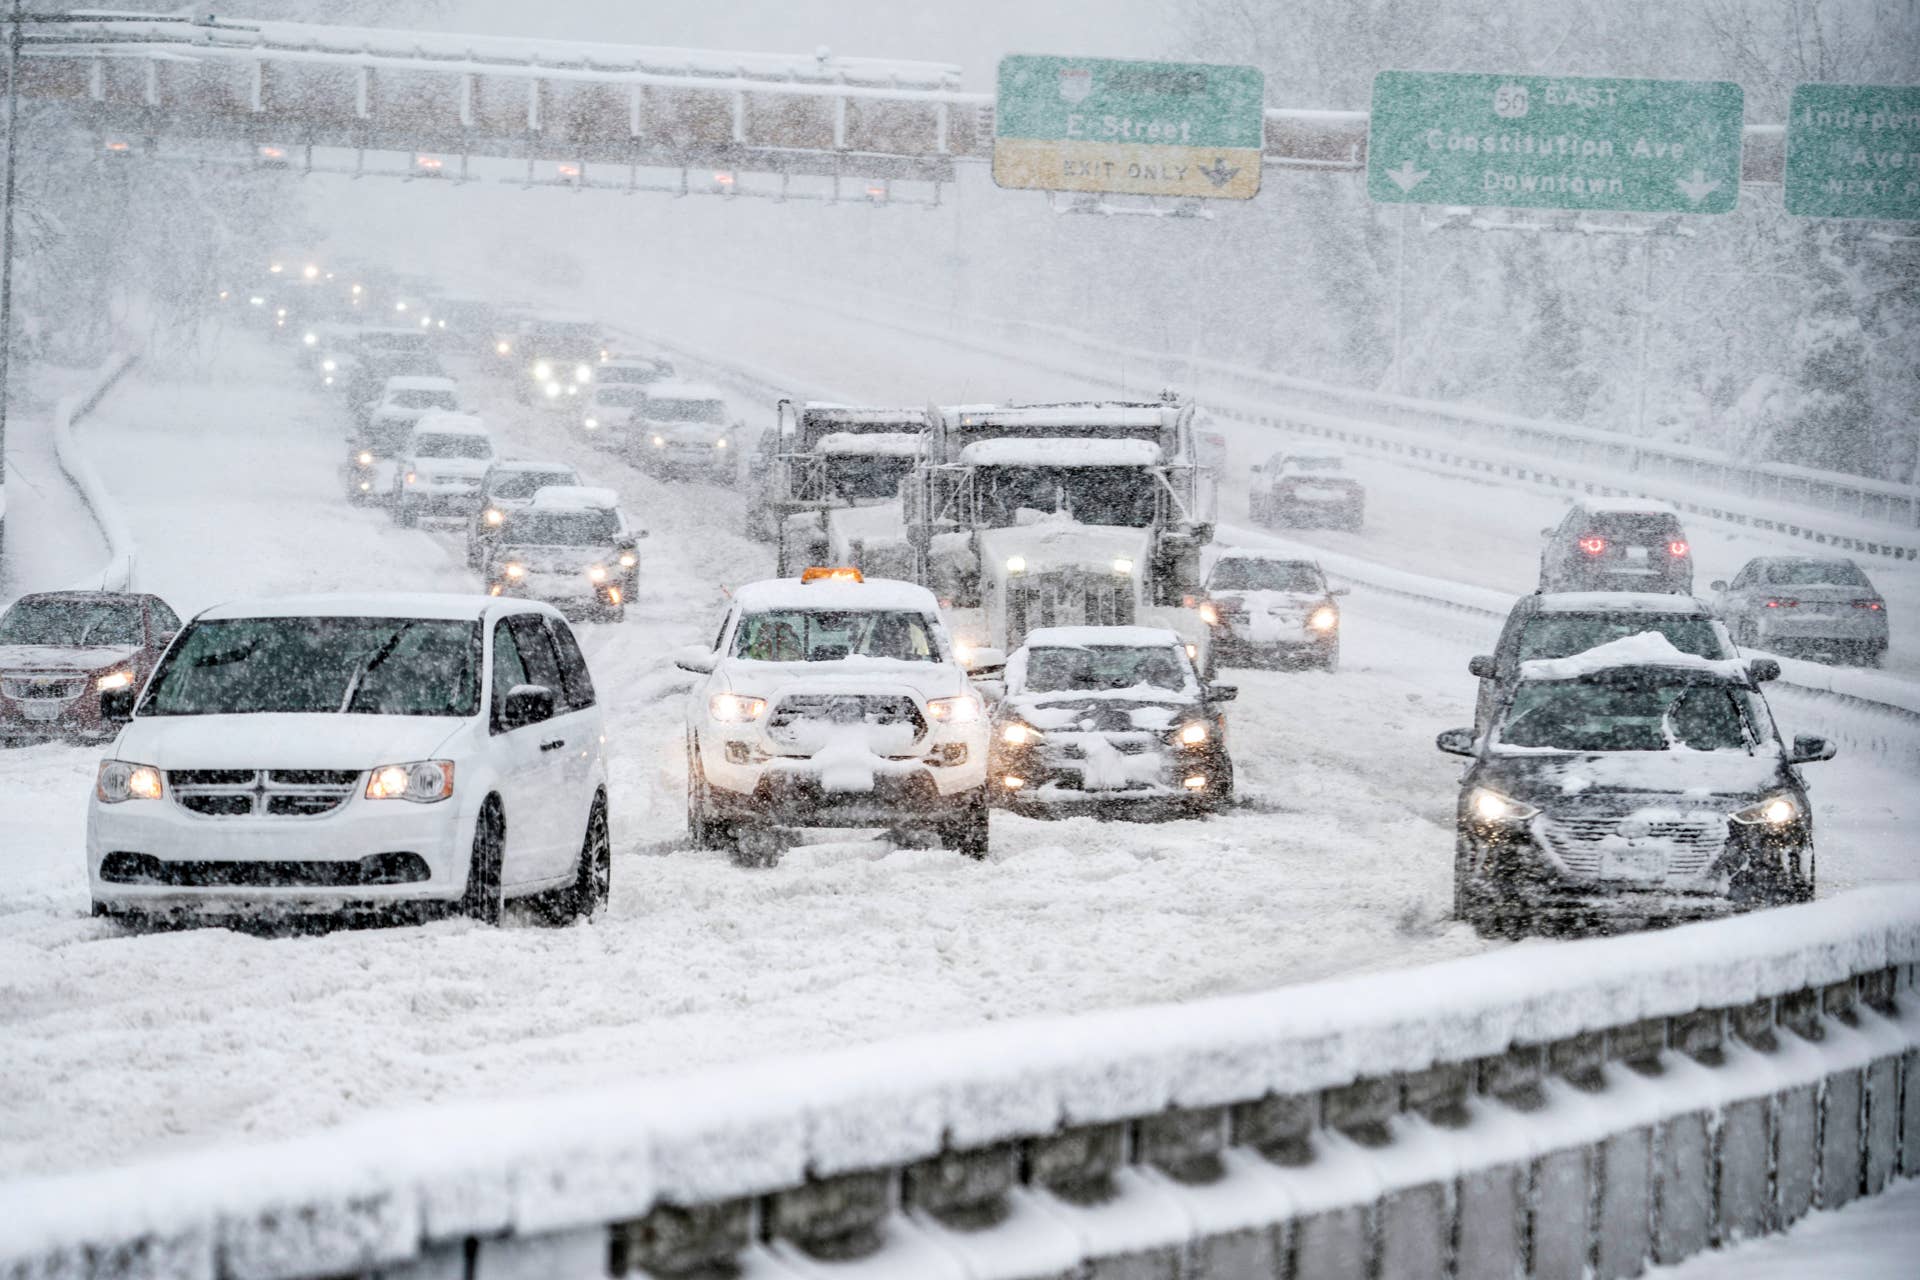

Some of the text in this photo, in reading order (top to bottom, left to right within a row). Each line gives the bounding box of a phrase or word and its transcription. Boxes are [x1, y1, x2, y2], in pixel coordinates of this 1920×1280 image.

[1544, 86, 1618, 108] EAST
[1066, 114, 1193, 141] E Street
[1426, 128, 1686, 160] Constitution Ave
[1063, 159, 1189, 181] EXIT ONLY
[1482, 170, 1625, 195] Downtown
